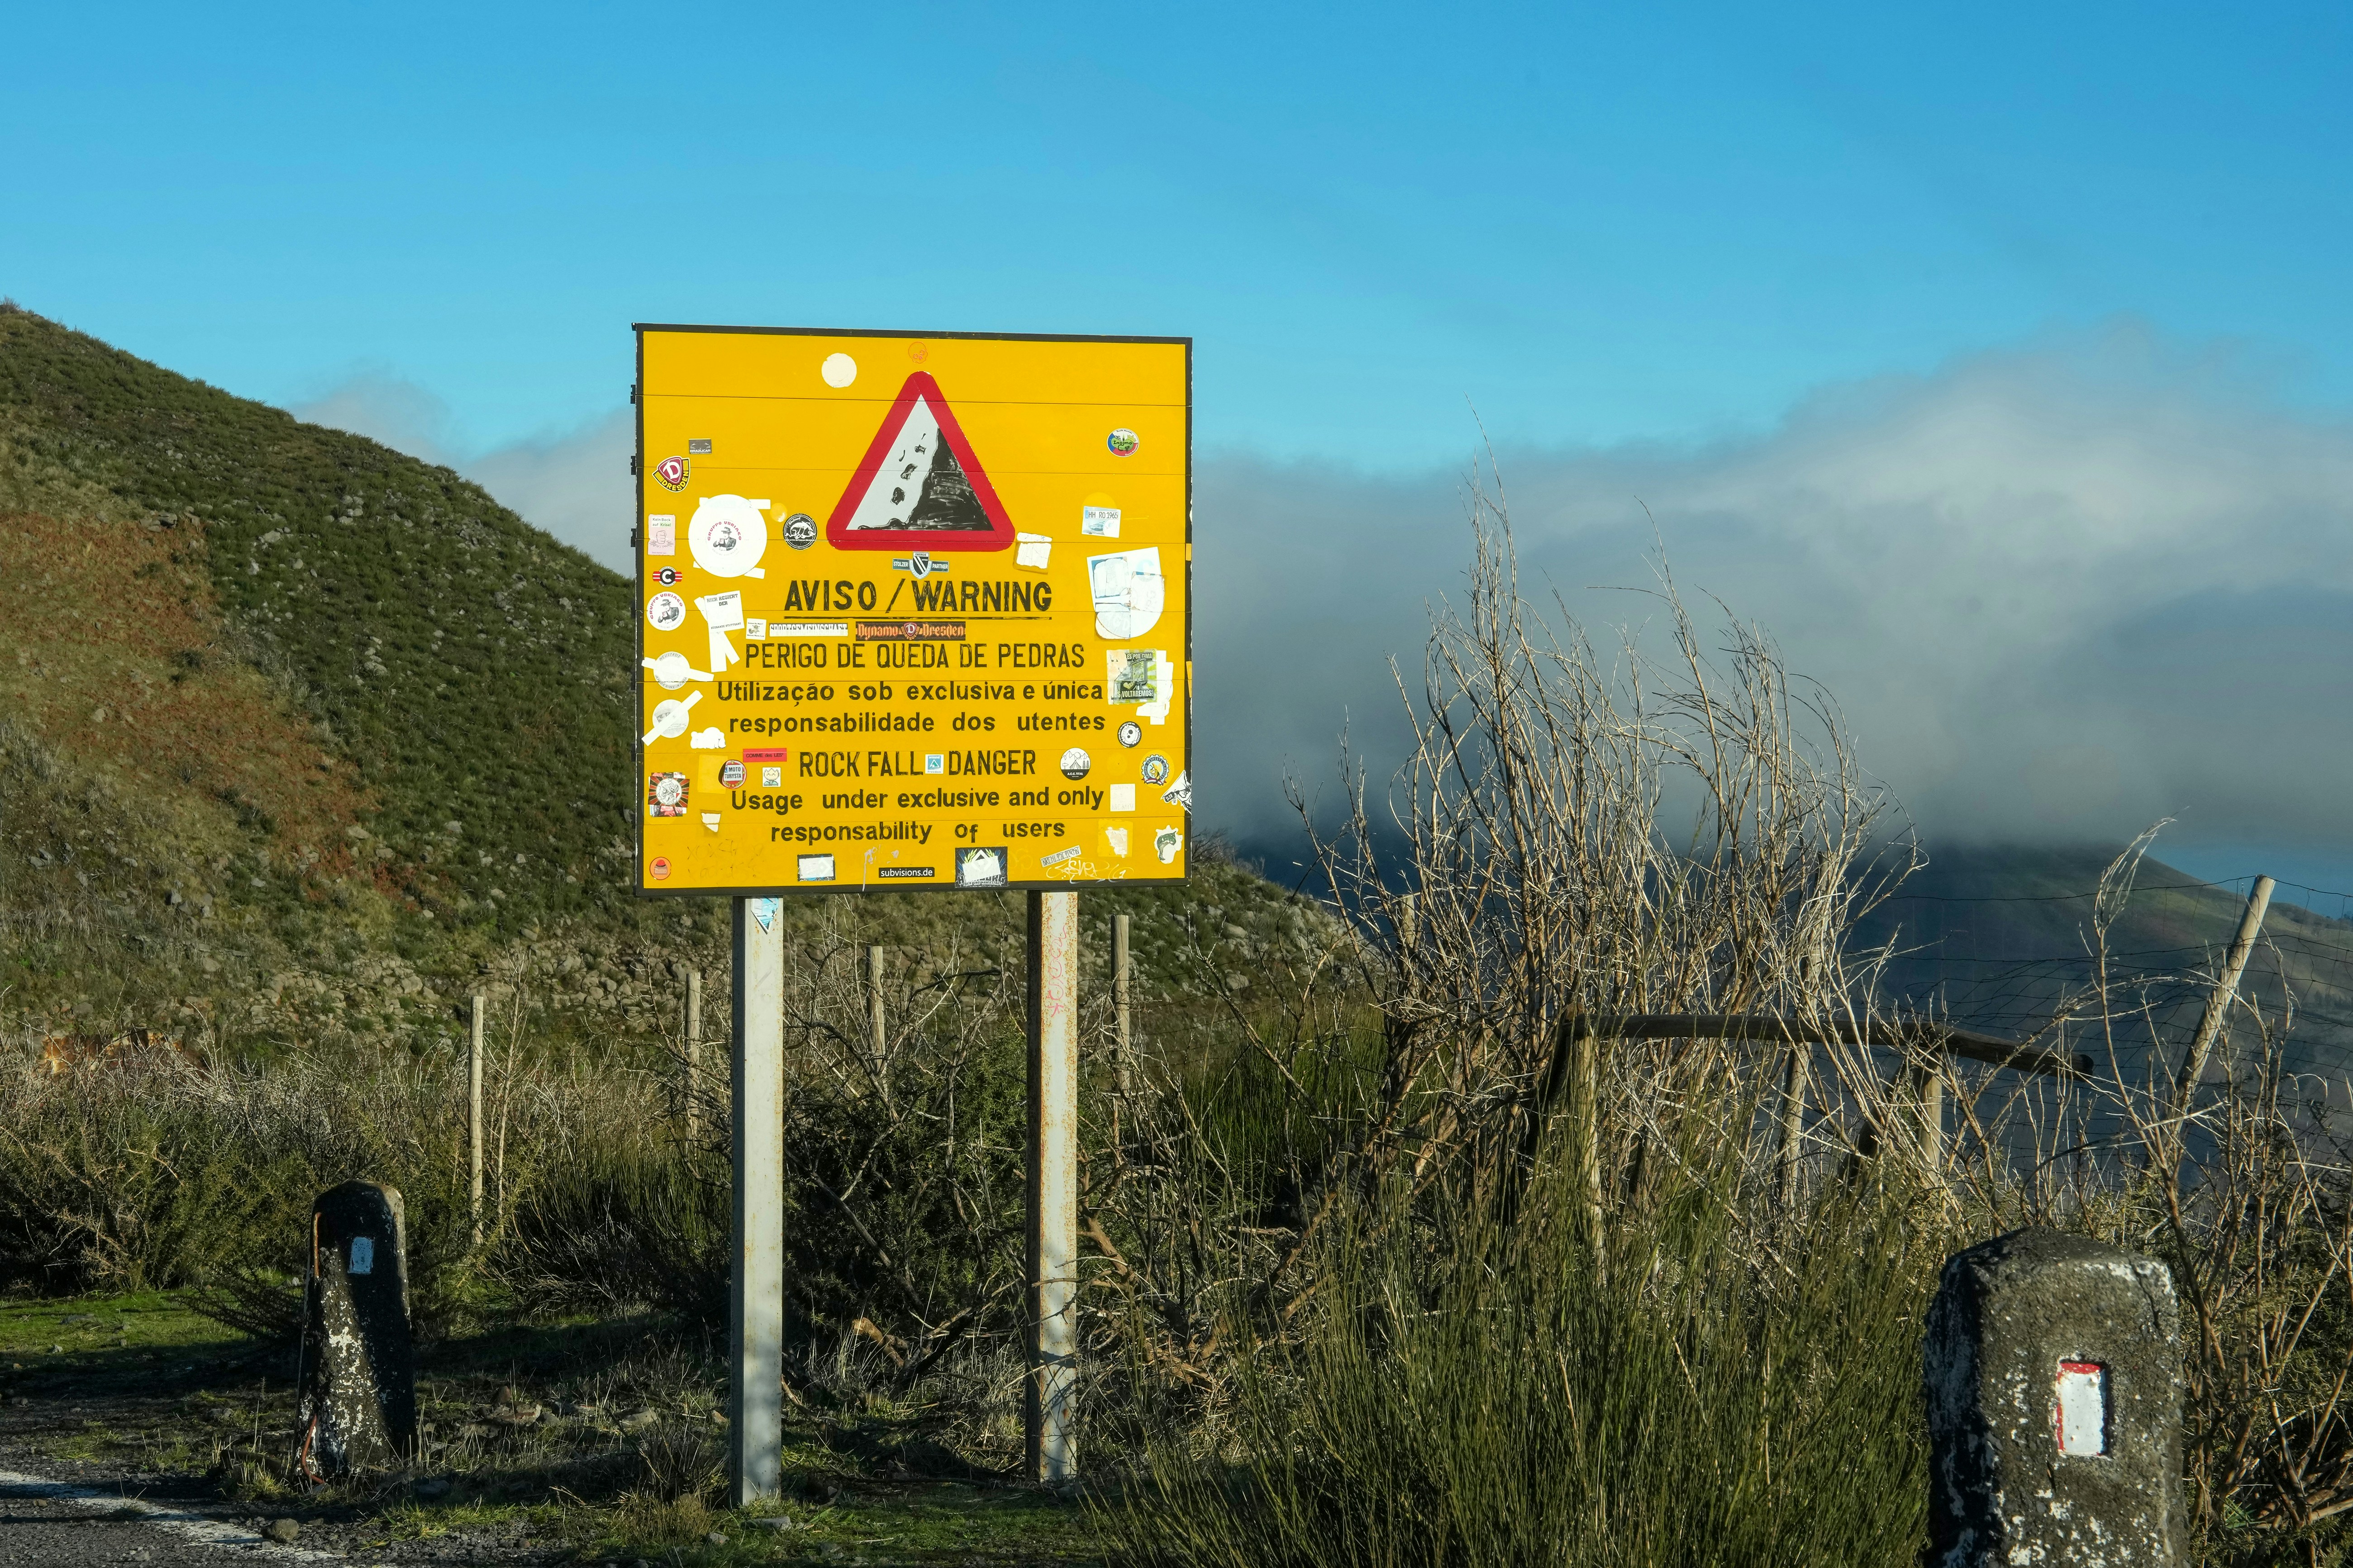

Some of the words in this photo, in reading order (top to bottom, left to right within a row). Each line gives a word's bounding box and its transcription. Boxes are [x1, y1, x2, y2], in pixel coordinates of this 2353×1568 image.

[661, 471, 689, 491] DRESDEN
[663, 461, 681, 480] D
[707, 522, 722, 541] GRUPPO
[724, 521, 742, 541] UBRIACO
[649, 597, 659, 619] GRUPPO
[660, 593, 683, 607] UBRIACO
[784, 580, 876, 611] AVISO
[911, 580, 1052, 612] WARNING
[858, 622, 899, 641] Dynamo
[903, 631, 919, 641] DRESDEN
[922, 622, 964, 638] Dresden
[659, 652, 681, 661] NEUSTADT
[746, 643, 827, 668] PERIGO
[838, 643, 866, 668] DE
[877, 643, 949, 668] QUEDA
[959, 643, 987, 668] DE
[998, 643, 1084, 668] PEDRAS
[718, 681, 834, 707] Utilização
[849, 681, 892, 701] sob
[907, 681, 1015, 700] exclusiva
[1024, 685, 1035, 699] e
[1043, 681, 1103, 700] única
[730, 712, 934, 737] responsabilidade
[953, 712, 995, 731] dos
[1018, 712, 1105, 731] utentes
[800, 751, 860, 777] ROCK
[868, 751, 924, 776] FALL
[948, 750, 1035, 775] DANGER
[732, 790, 803, 816] Usage
[823, 789, 888, 809] under
[897, 788, 999, 808] exclusive
[1009, 787, 1049, 806] and
[1058, 785, 1104, 811] only
[772, 821, 932, 846] responsability
[955, 823, 978, 843] of
[1003, 822, 1065, 837] users
[881, 868, 933, 877] subvisions.de
